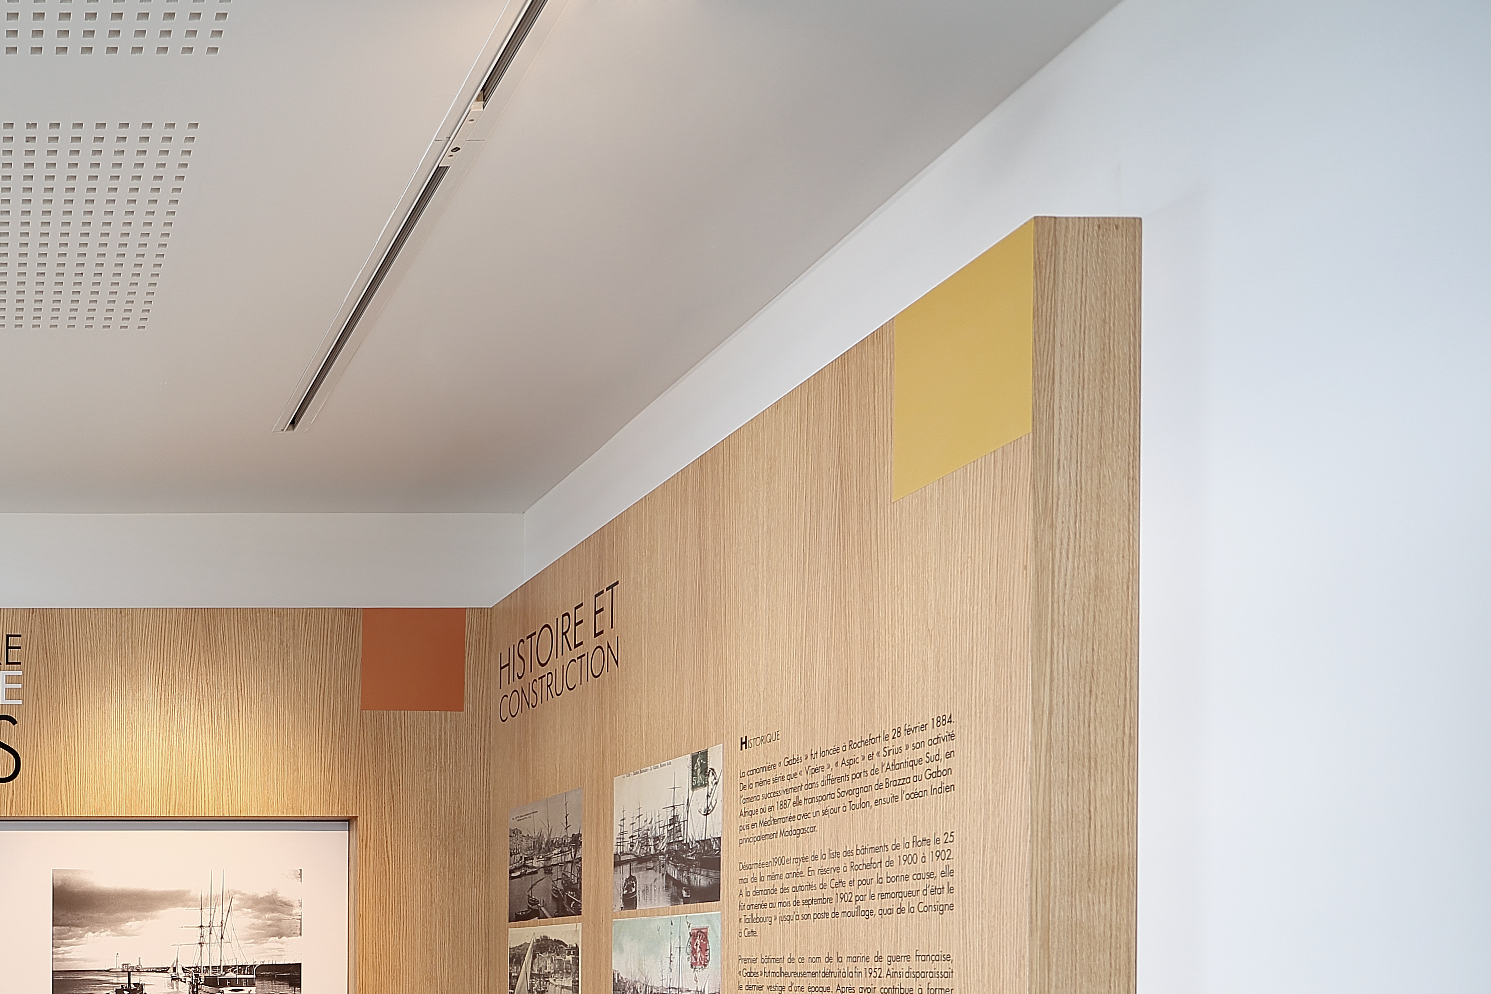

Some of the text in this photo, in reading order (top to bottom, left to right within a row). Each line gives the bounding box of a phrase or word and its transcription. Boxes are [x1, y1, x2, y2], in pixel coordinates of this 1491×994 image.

[499, 580, 620, 689] HISTOIRE ET
[499, 636, 619, 722] CONSTRUCTION
[849, 733, 881, 751] Rochefort
[905, 722, 928, 737] février
[932, 713, 955, 730] 1884.
[841, 755, 860, 769] Aspic
[882, 745, 903, 758] Sirius
[928, 730, 956, 747] activité
[852, 768, 869, 783] ports
[881, 757, 923, 774] l'Atlantique
[925, 748, 943, 764] Sud,
[885, 776, 911, 789] Brazza
[924, 765, 953, 781] Gabon
[849, 781, 955, 811] Toulon, ensuite l'océan Indien
[856, 842, 889, 856] bâtiments
[912, 835, 931, 848] flotte
[850, 857, 882, 872] Rochefort
[898, 852, 918, 866] 1900
[931, 848, 954, 862] 1902.
[886, 871, 910, 884] bonne
[912, 871, 937, 881] cause,
[940, 864, 955, 878] elle
[878, 889, 920, 902] remorqueur
[922, 884, 945, 897] d'état
[841, 905, 876, 920] mouillage,
[878, 905, 894, 919] quai
[917, 901, 954, 915] Consigne
[846, 953, 870, 963] marine
[887, 954, 911, 966] guerre
[915, 949, 953, 965] française,
[864, 966, 954, 982] 1952. Ainsi disparaissait
[859, 984, 877, 994] avoir
